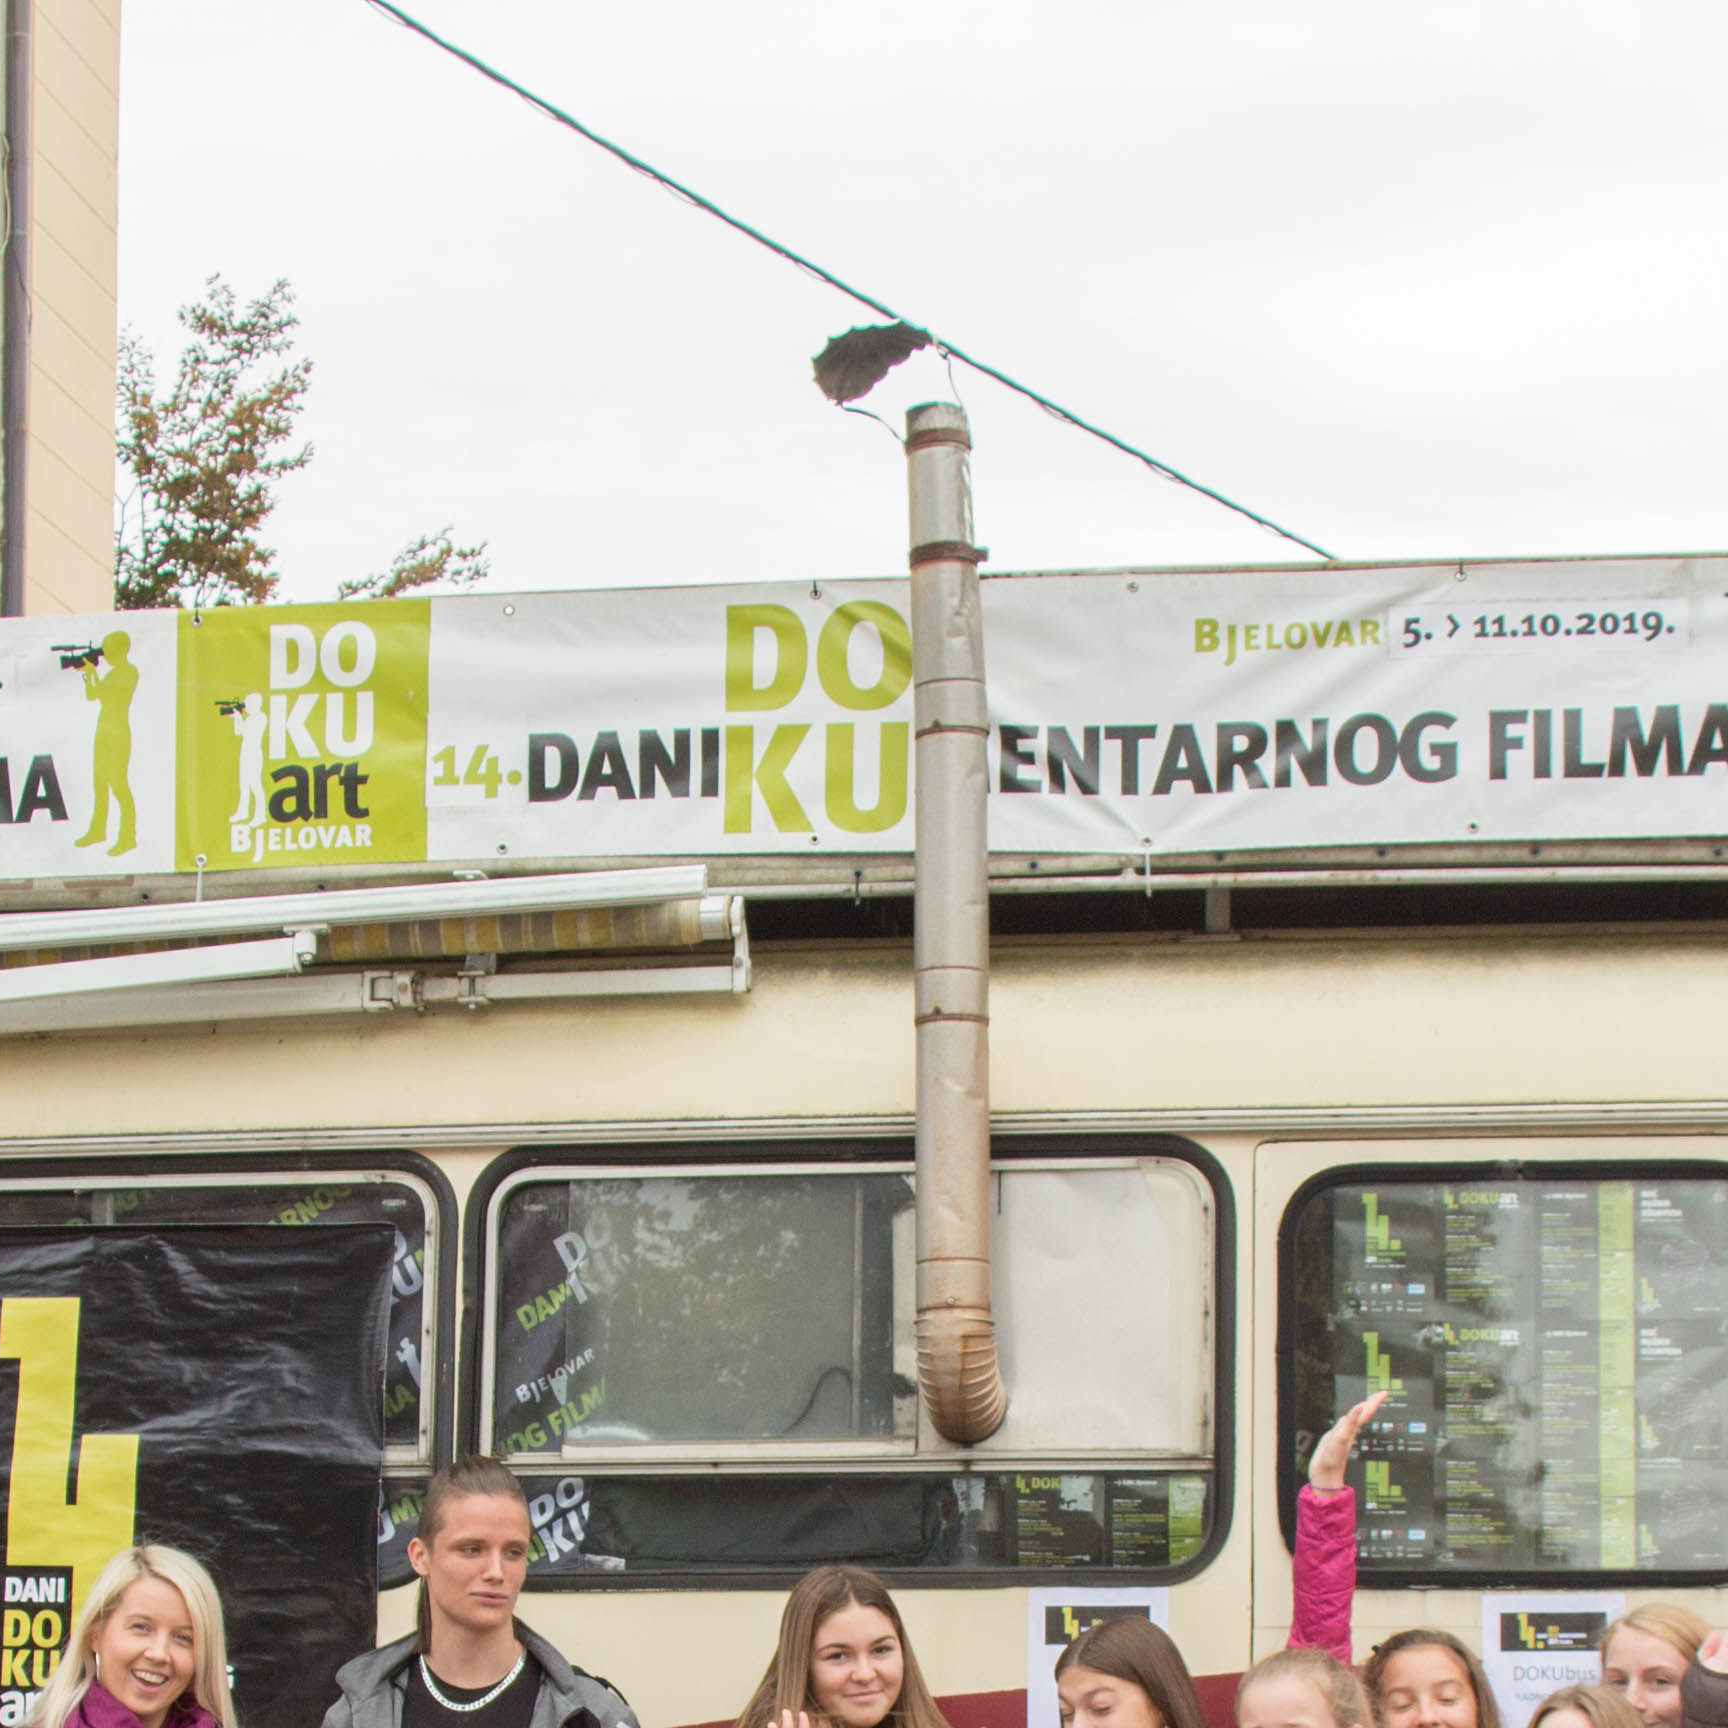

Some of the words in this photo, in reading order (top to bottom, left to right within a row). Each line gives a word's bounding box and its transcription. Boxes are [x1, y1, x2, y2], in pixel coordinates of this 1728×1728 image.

[270, 622, 376, 691] DO
[725, 600, 914, 713] DO
[1195, 617, 1381, 666] BJELOVAR
[1403, 617, 1434, 647] 5.
[1473, 609, 1675, 640] 11.10.2019.
[269, 691, 374, 758] KU
[267, 762, 369, 824] art
[433, 744, 522, 799] 14.
[529, 728, 719, 803] DANI
[723, 722, 909, 835] KU
[989, 711, 1458, 796] ENTARNOG
[231, 822, 373, 863] BJELOVAR
[529, 1477, 584, 1528] DO
[4, 1577, 65, 1603] DANI
[3, 1609, 62, 1648] DO
